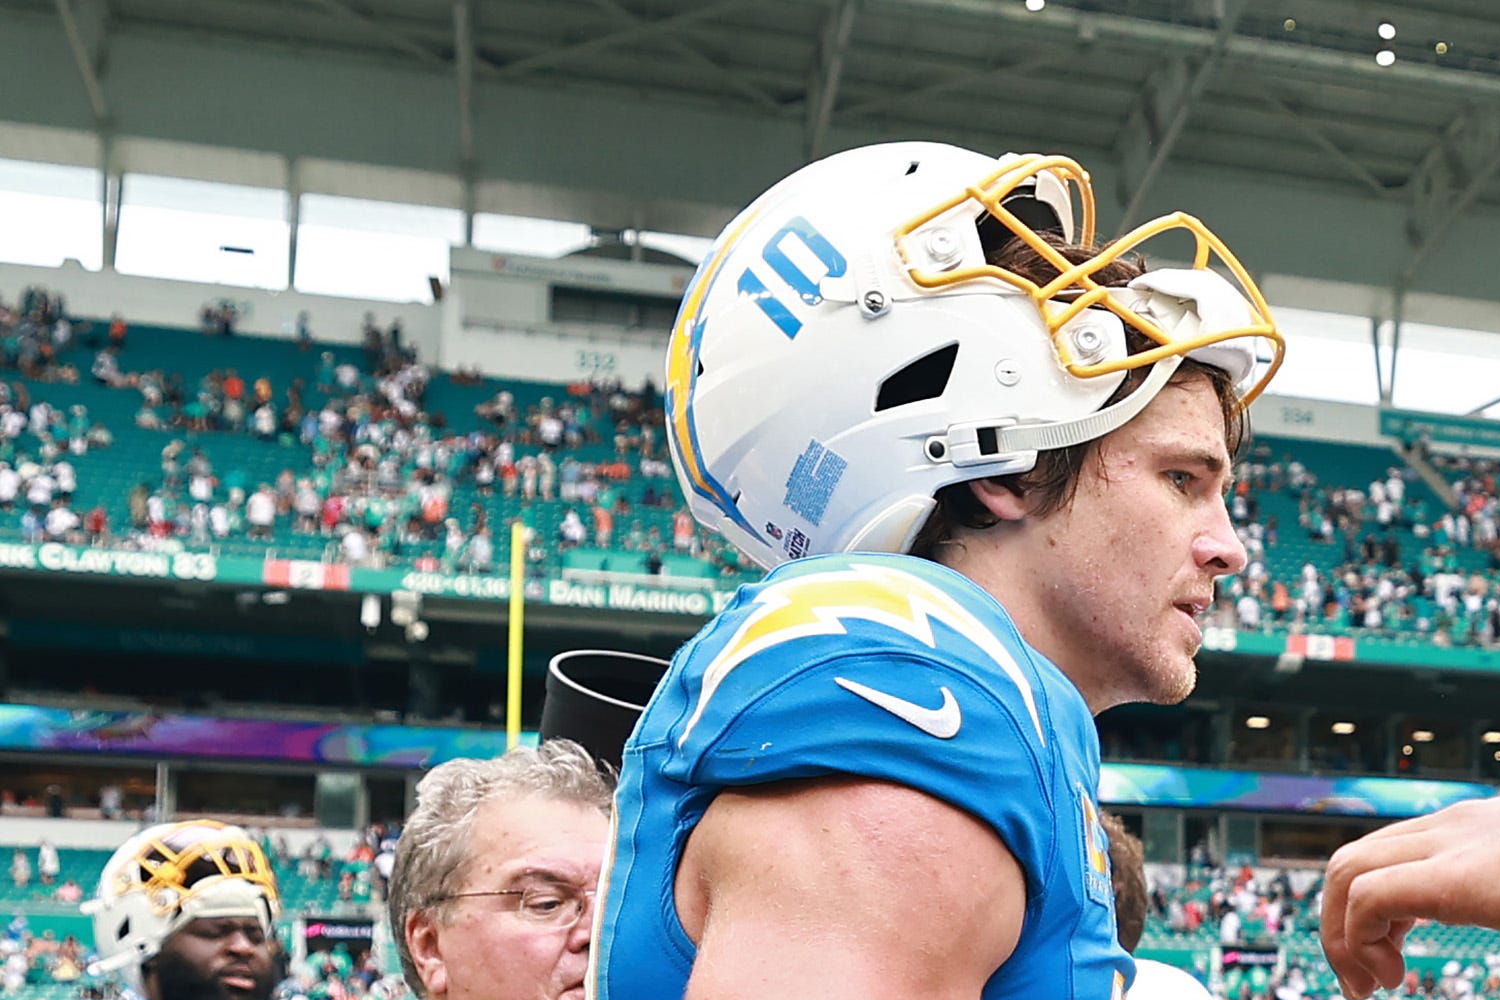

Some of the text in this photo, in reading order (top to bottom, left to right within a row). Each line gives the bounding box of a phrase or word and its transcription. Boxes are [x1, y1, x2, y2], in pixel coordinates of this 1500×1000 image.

[737, 215, 847, 340] 10
[38, 542, 170, 578] CLAYTON
[550, 579, 605, 608] DAN
[609, 582, 708, 616] MARINO
